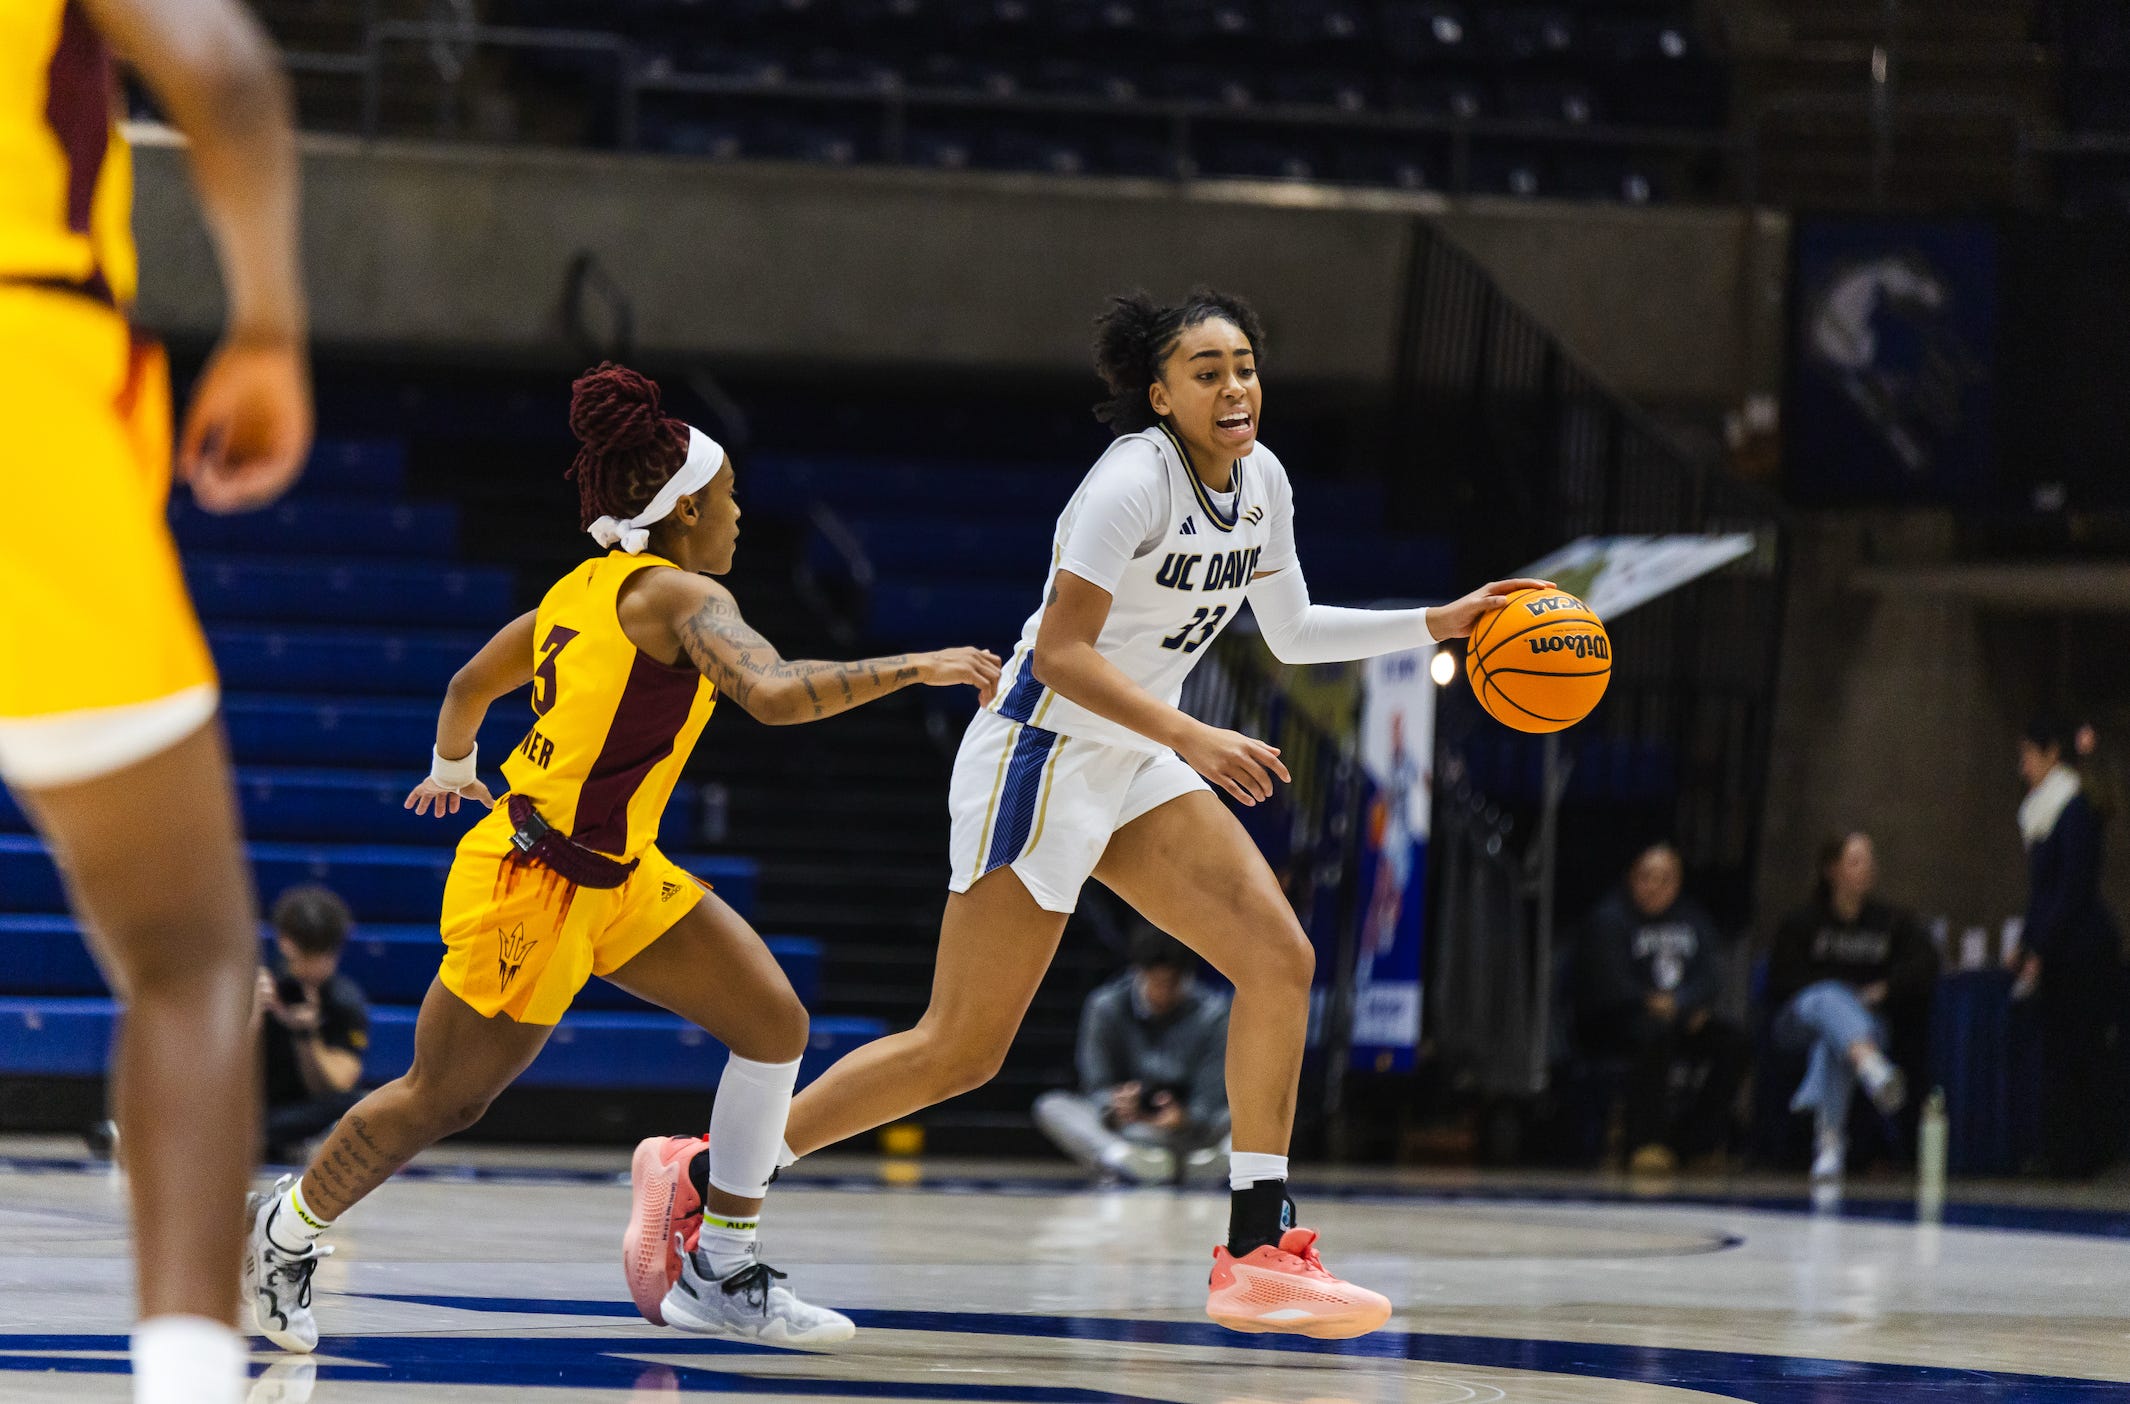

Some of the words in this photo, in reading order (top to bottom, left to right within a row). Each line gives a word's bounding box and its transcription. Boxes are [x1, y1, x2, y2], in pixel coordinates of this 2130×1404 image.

[1155, 553, 1203, 592] UC
[1525, 596, 1590, 618] NCAA
[1160, 604, 1228, 655] 33
[1528, 633, 1609, 661] Wilson
[533, 624, 581, 717] 3
